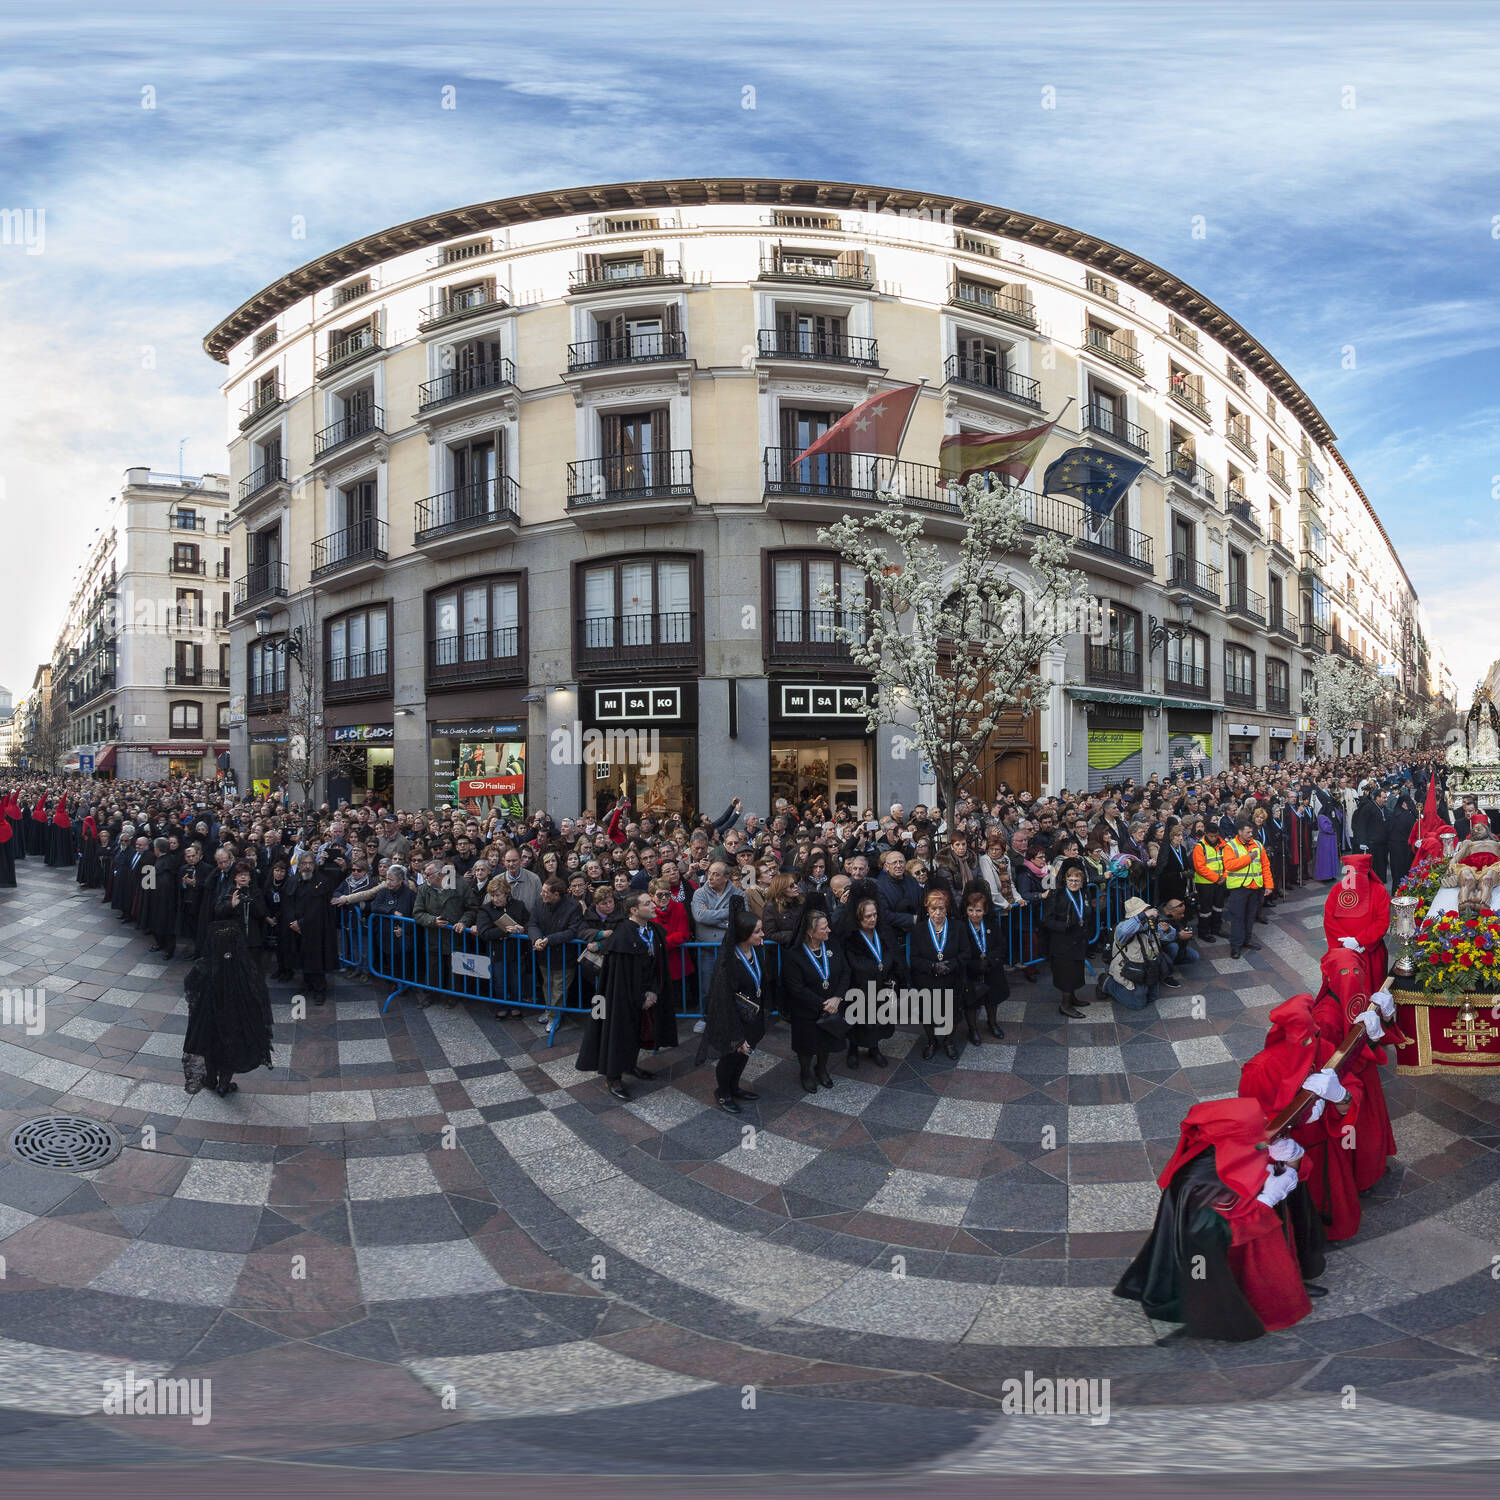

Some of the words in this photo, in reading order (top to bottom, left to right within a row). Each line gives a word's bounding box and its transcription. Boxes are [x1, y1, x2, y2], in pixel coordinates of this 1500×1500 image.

[604, 701, 616, 709] MI
[630, 700, 644, 708] SA
[657, 699, 672, 707] KO
[791, 697, 803, 705] MI
[485, 783, 516, 791] Kalenji
